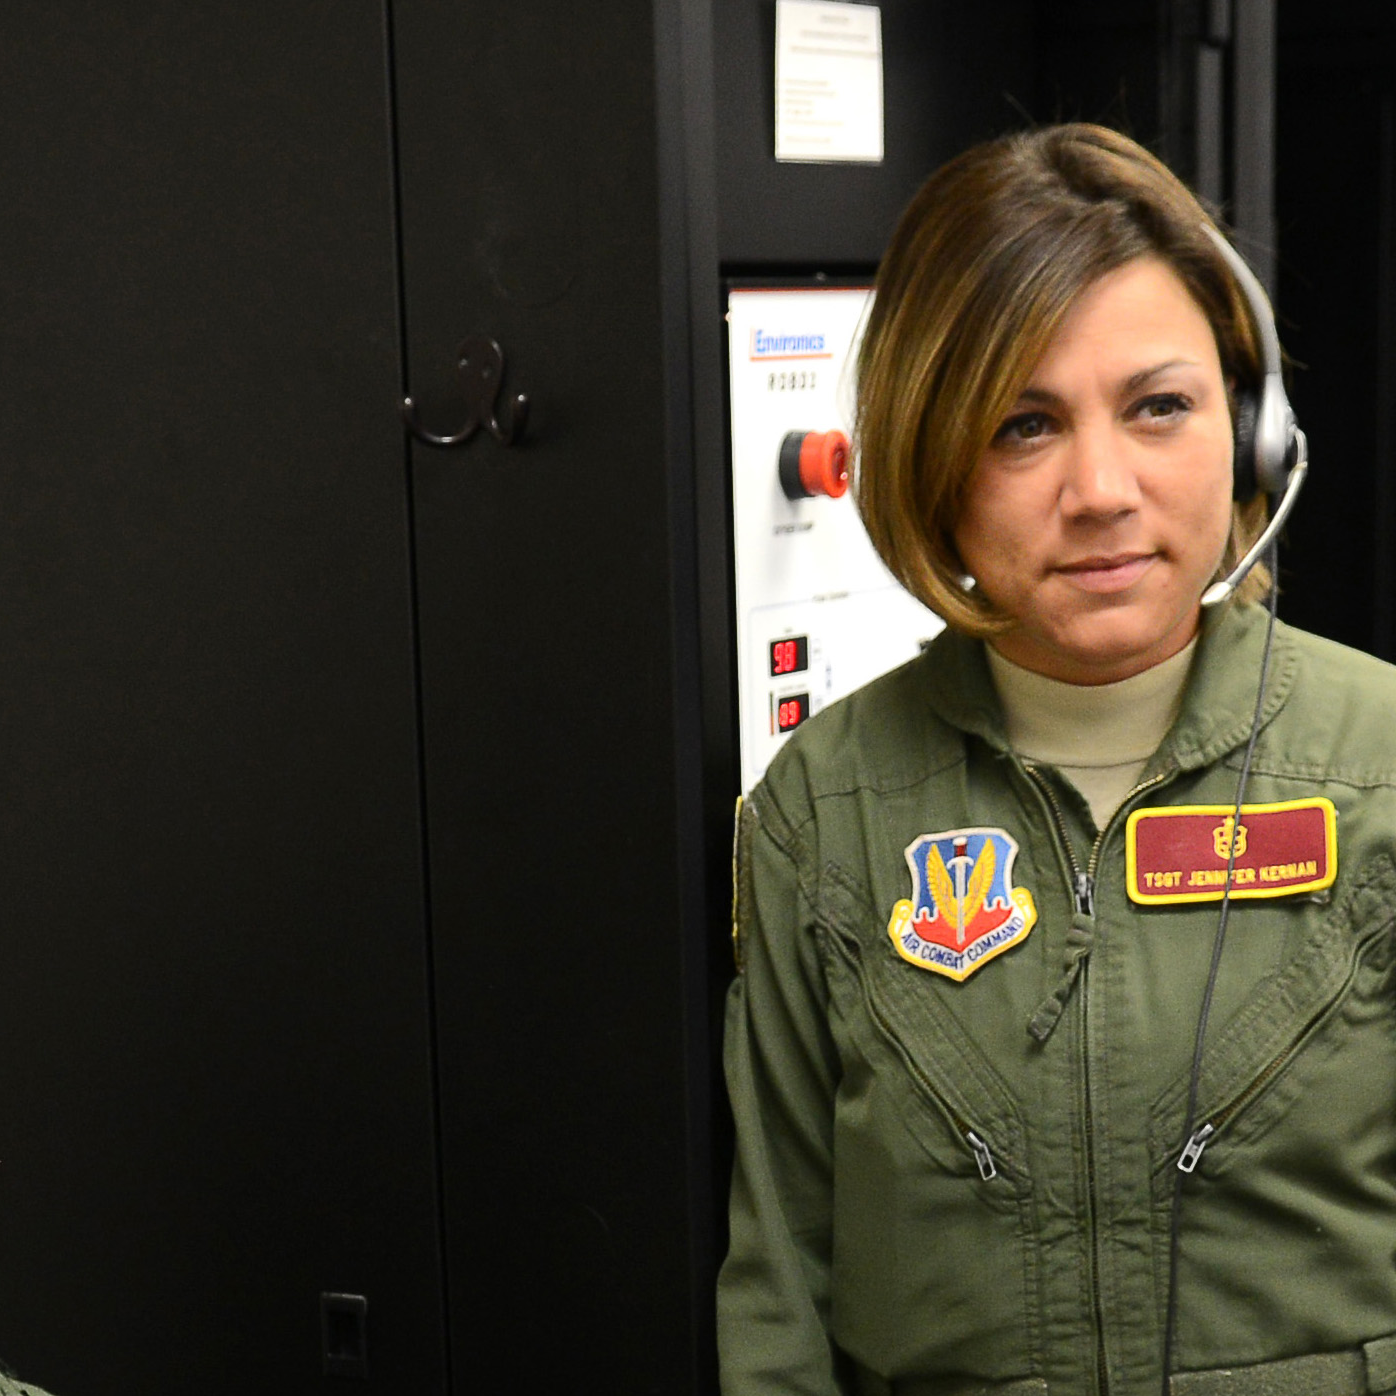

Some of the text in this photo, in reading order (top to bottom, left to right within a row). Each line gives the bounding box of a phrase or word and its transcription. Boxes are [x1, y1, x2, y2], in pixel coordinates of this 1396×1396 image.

[1144, 870, 1183, 889] TSGT
[900, 915, 1025, 970] AIR COMBAT COMMAND
